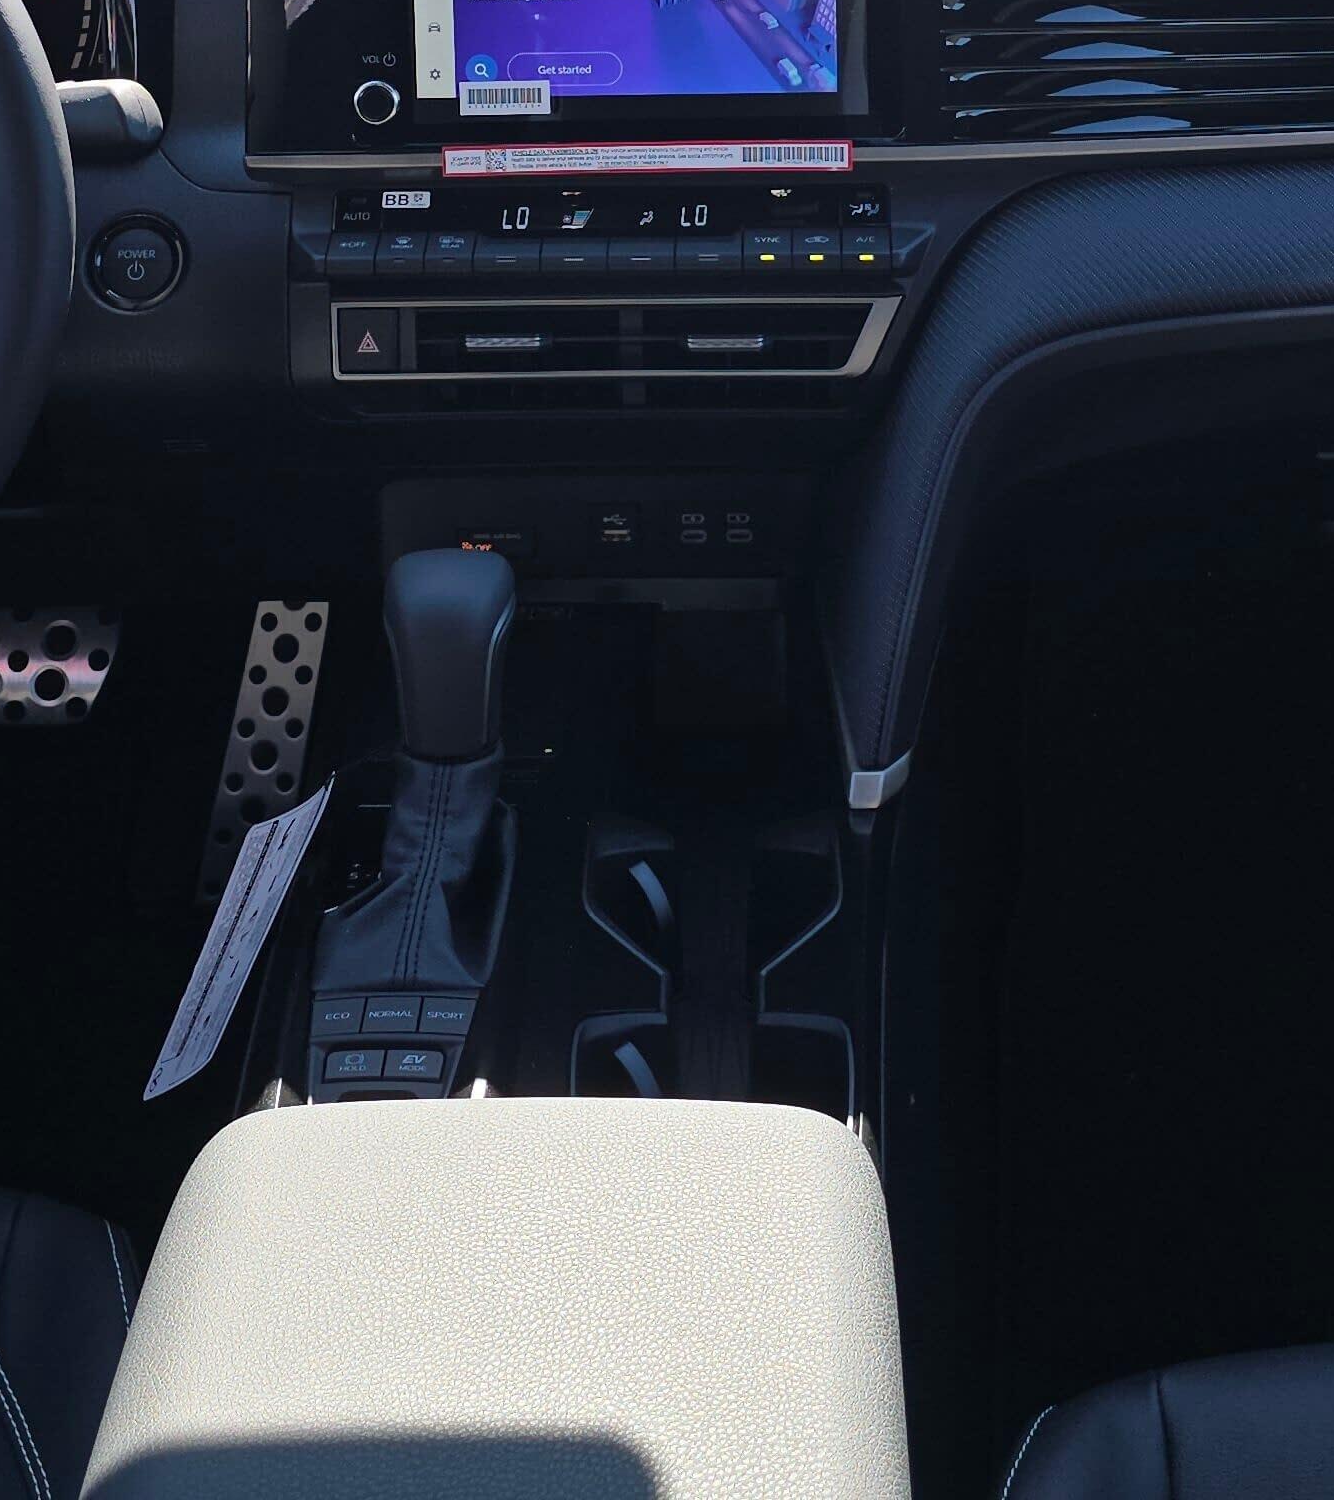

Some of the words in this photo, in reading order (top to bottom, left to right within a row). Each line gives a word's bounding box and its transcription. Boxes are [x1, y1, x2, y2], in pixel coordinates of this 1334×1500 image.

[362, 54, 380, 64] VOL
[537, 64, 556, 76] Get
[558, 64, 593, 75] started
[384, 193, 410, 206] BB
[342, 211, 371, 221] AUTO
[501, 206, 530, 230] LO
[680, 204, 708, 227] LO
[754, 236, 781, 244] SYNC
[855, 235, 876, 244] A/C
[349, 240, 366, 249] OFF
[117, 249, 156, 259] POWER
[324, 1011, 351, 1020] ECO
[368, 1010, 414, 1019] NORMAL
[426, 1011, 466, 1020] SPORT
[401, 1054, 427, 1064] EV
[338, 1064, 367, 1073] HOLD
[398, 1064, 427, 1072] MODE
